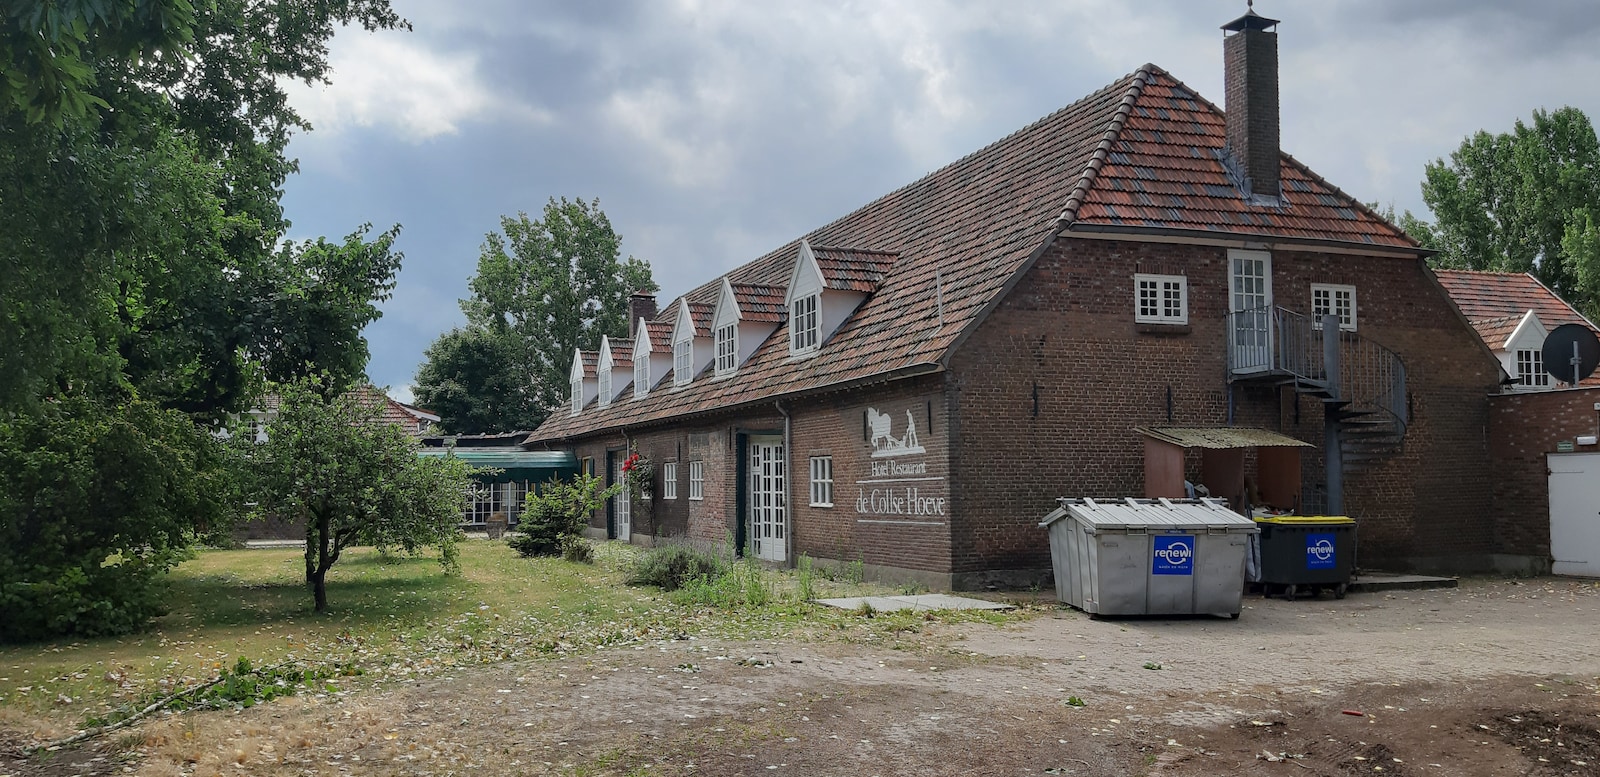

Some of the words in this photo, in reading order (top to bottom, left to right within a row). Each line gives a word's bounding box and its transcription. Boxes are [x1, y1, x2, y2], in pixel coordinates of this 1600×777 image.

[871, 461, 889, 476] Hotel
[891, 459, 926, 475] Restaurant
[856, 488, 868, 513] de
[871, 488, 904, 514] Collse
[906, 487, 945, 515] Hoeve
[1155, 547, 1192, 558] renewi
[1307, 545, 1334, 554] renewi
